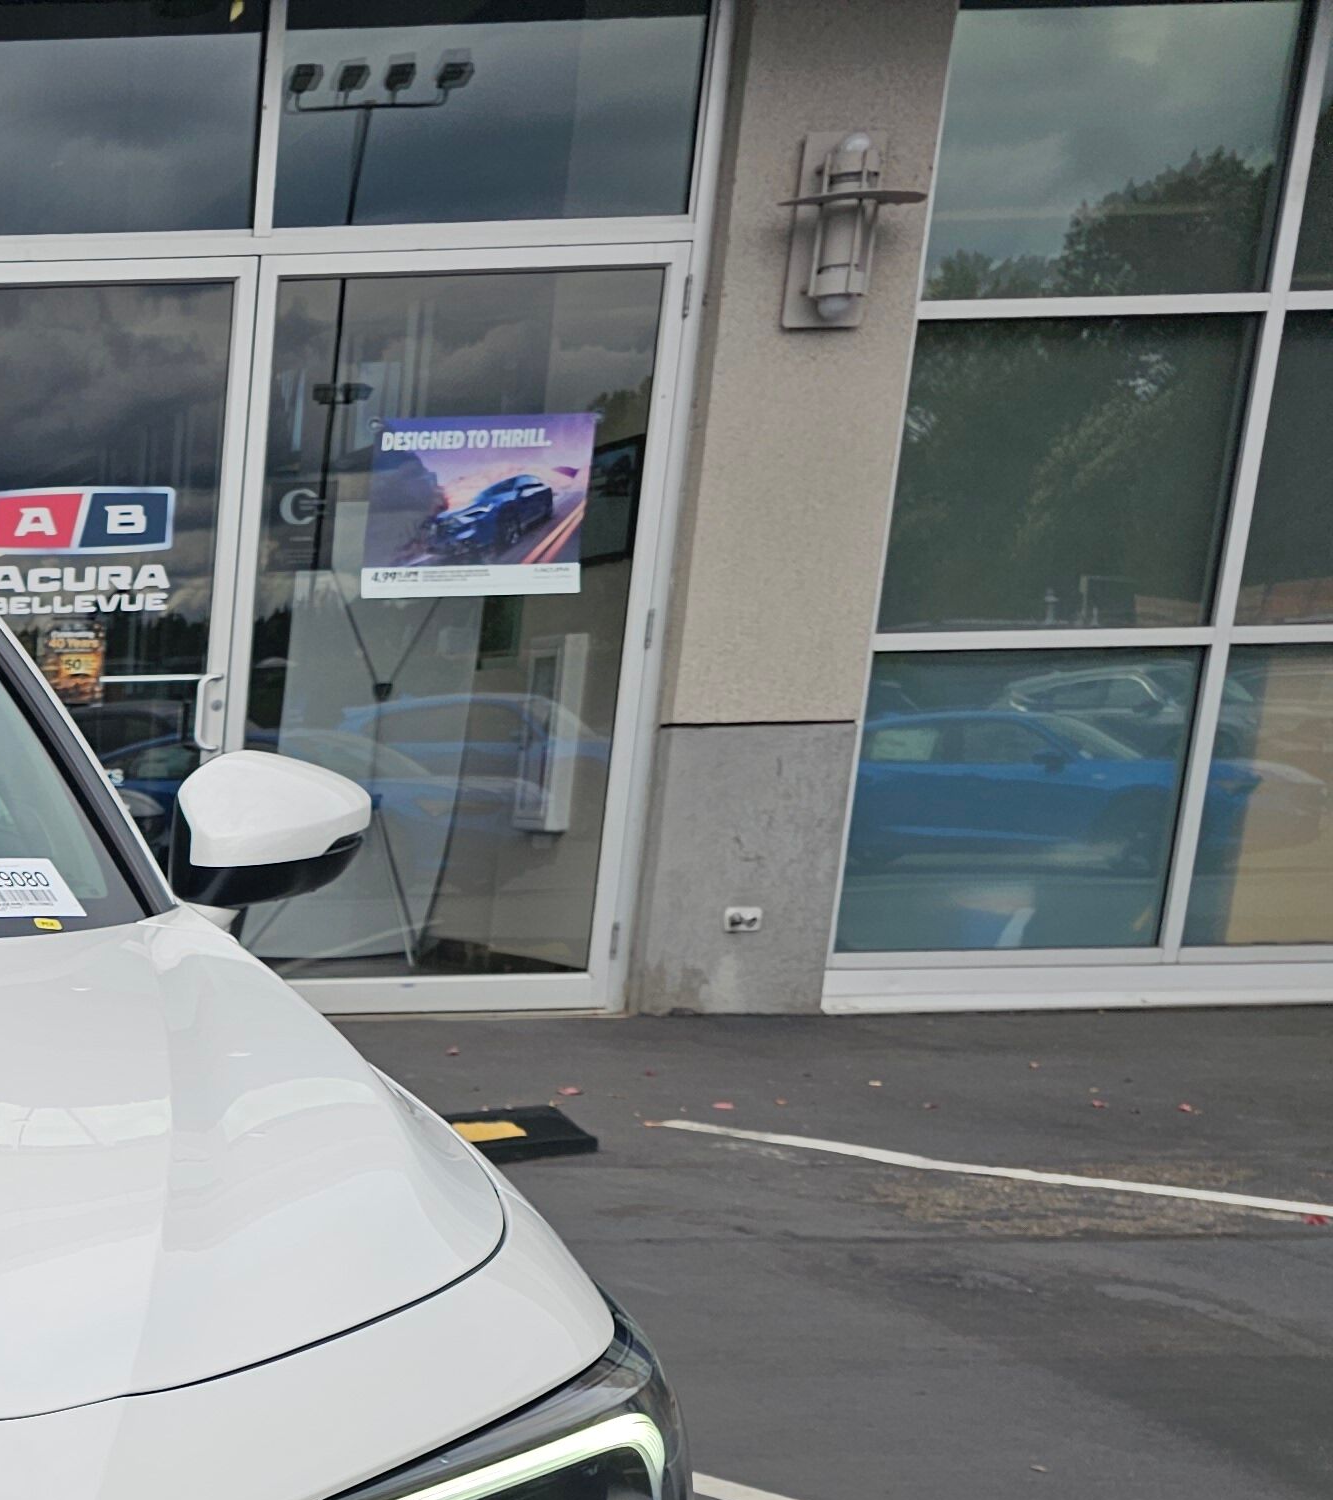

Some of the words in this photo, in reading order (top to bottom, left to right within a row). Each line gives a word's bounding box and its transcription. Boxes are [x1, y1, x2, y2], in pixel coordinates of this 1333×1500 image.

[381, 430, 464, 451] DESIGNED
[466, 429, 490, 449] TO
[491, 428, 552, 448] THRILL.
